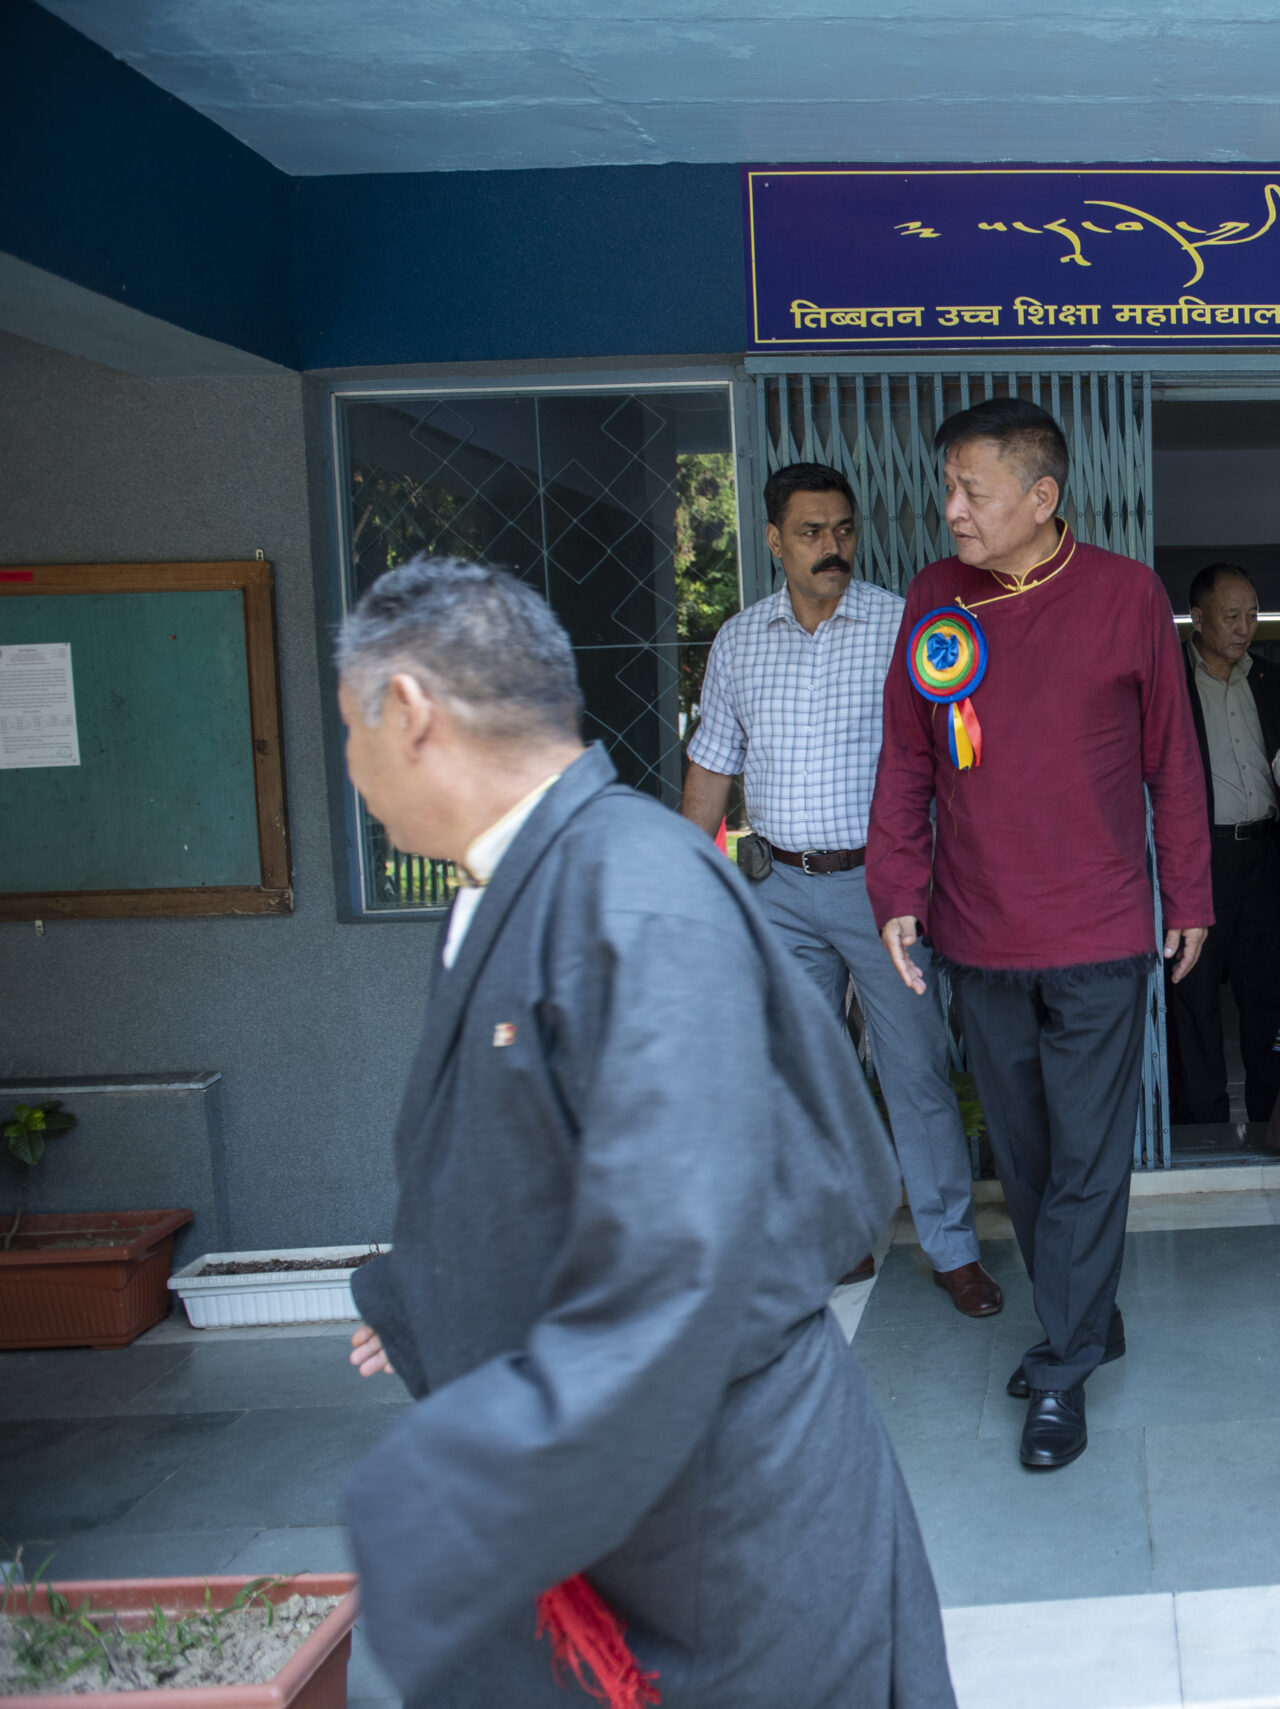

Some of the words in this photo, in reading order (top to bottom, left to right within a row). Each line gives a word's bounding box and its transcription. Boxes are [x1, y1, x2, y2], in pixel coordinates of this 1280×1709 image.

[789, 299, 925, 329] तिब्बतन
[935, 305, 1003, 326] उच्च
[1012, 296, 1102, 327] शिक्षा
